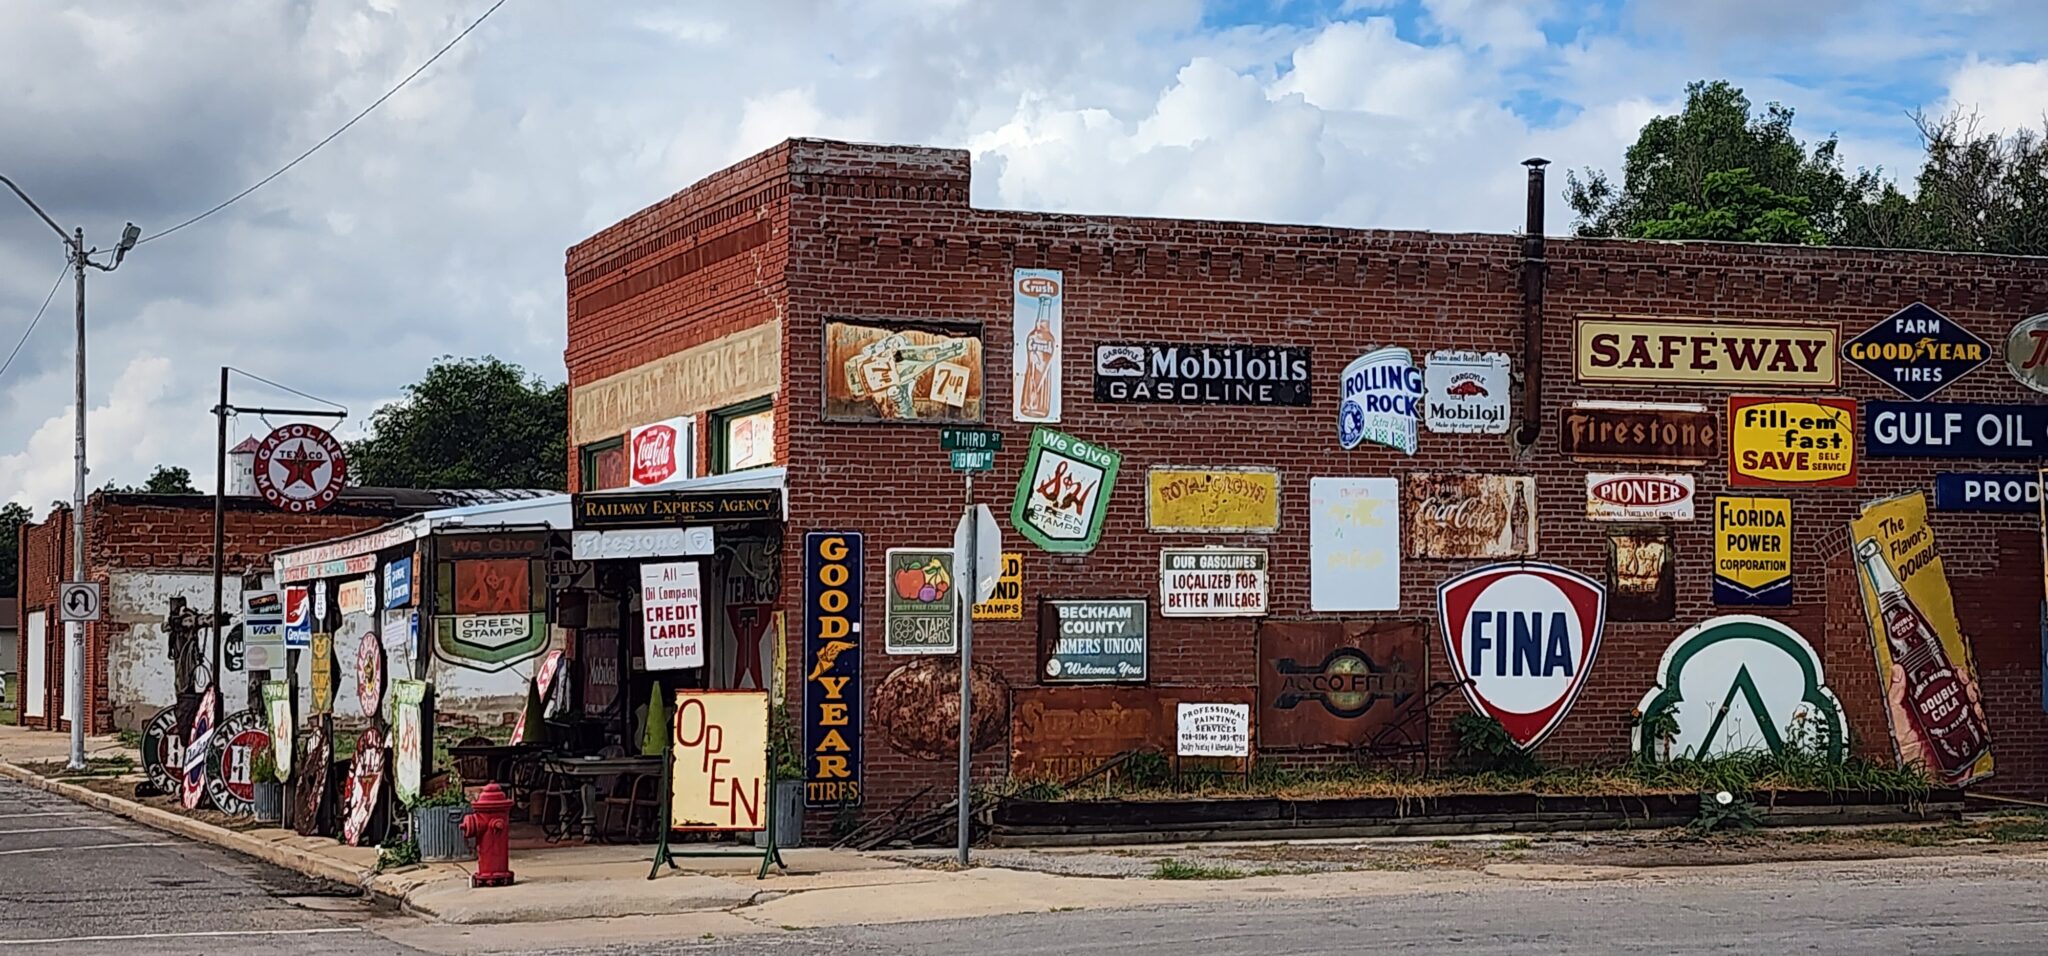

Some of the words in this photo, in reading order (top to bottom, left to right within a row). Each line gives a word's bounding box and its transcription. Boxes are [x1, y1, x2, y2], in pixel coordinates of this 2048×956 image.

[1022, 280, 1055, 294] Crush
[1896, 319, 1940, 334] FARM
[1103, 347, 1139, 360] GARGOYLE
[1449, 354, 1461, 362] and
[1590, 334, 1827, 373] SAFEWAY
[1851, 343, 1982, 361] GOODYEAR
[1151, 347, 1307, 381] Mobiloils
[1346, 365, 1422, 398] ROLLING
[1451, 372, 1487, 385] GARGOYLE
[1894, 367, 1943, 382] TIRES
[577, 383, 614, 424] CITY
[617, 368, 664, 419] MEAT
[1110, 382, 1273, 401] GASOLINE
[1367, 394, 1424, 419] ROCK
[1430, 403, 1505, 421] Mobiloil
[1372, 415, 1389, 428] Extra
[1874, 411, 1962, 445] GULF
[1977, 413, 2033, 447] OIL
[943, 431, 950, 439] W
[956, 431, 987, 447] THIRD
[992, 433, 1000, 441] ST
[1566, 414, 1714, 447] Firestone
[1785, 429, 1842, 448] fast
[259, 425, 342, 462] GASOLINE
[1043, 430, 1068, 450] We
[1072, 442, 1111, 466] Give
[280, 450, 323, 460] TEXACO
[1742, 450, 1809, 470] SAVE
[1818, 452, 1840, 461] SELF
[1812, 463, 1847, 471] SERVICE
[257, 474, 317, 511] MOTOR
[323, 475, 344, 502] OIL
[1160, 477, 1208, 503] ROYAL
[1601, 480, 1682, 503] PIONEER
[586, 503, 648, 516] RAILWAY
[653, 500, 714, 514] EXPRESS
[719, 499, 772, 513] AGENCY
[1033, 503, 1084, 527] GREEN
[1594, 508, 1624, 518] NATIONAL
[1624, 508, 1654, 518] PORTLAND
[1720, 501, 1786, 531] FLORIDA
[1031, 512, 1081, 535] STAMPS
[1878, 517, 1905, 540] The
[488, 538, 536, 552] Give
[579, 535, 681, 556] Firestone
[1727, 534, 1781, 552] POWER
[1173, 555, 1196, 568] OUR
[1200, 555, 1256, 568] GASOLINES
[1720, 559, 1786, 571] CORPORATION
[1898, 543, 1938, 582] DOUBLE
[663, 568, 677, 582] All
[1173, 573, 1232, 590] LOCALIZED
[1236, 574, 1257, 589] FOR
[645, 587, 656, 601] Oil
[659, 586, 698, 603] Company
[1169, 593, 1209, 608] BETTER
[1214, 593, 1261, 608] MILEAGE
[646, 604, 698, 622] CREDIT
[973, 604, 1020, 614] STAMPS
[1059, 606, 1132, 619] BECKHAM
[253, 625, 277, 635] VISA
[462, 617, 523, 629] GREEN
[650, 623, 695, 640] CARDS
[915, 617, 951, 642] STARK
[1063, 621, 1126, 634] COUNTY
[1891, 613, 1914, 633] DOUBLE
[1897, 623, 1915, 637] COLA
[462, 627, 524, 639] STAMPS
[928, 627, 951, 643] BROS
[652, 643, 696, 659] Accepted
[1103, 637, 1143, 654] UNION
[1471, 611, 1574, 677] FINA
[1064, 662, 1117, 675] Welcomes
[1118, 662, 1142, 678] You
[1282, 675, 1345, 692] ACCO
[1920, 680, 1960, 715] DOUBLE
[1182, 706, 1246, 720] PROFESSIONAL
[1931, 697, 1960, 722] COLA
[1194, 715, 1237, 725] PAINTING
[1196, 724, 1237, 733] SERVICES
[676, 698, 760, 826] OPEN
[808, 781, 859, 801] TIRES
